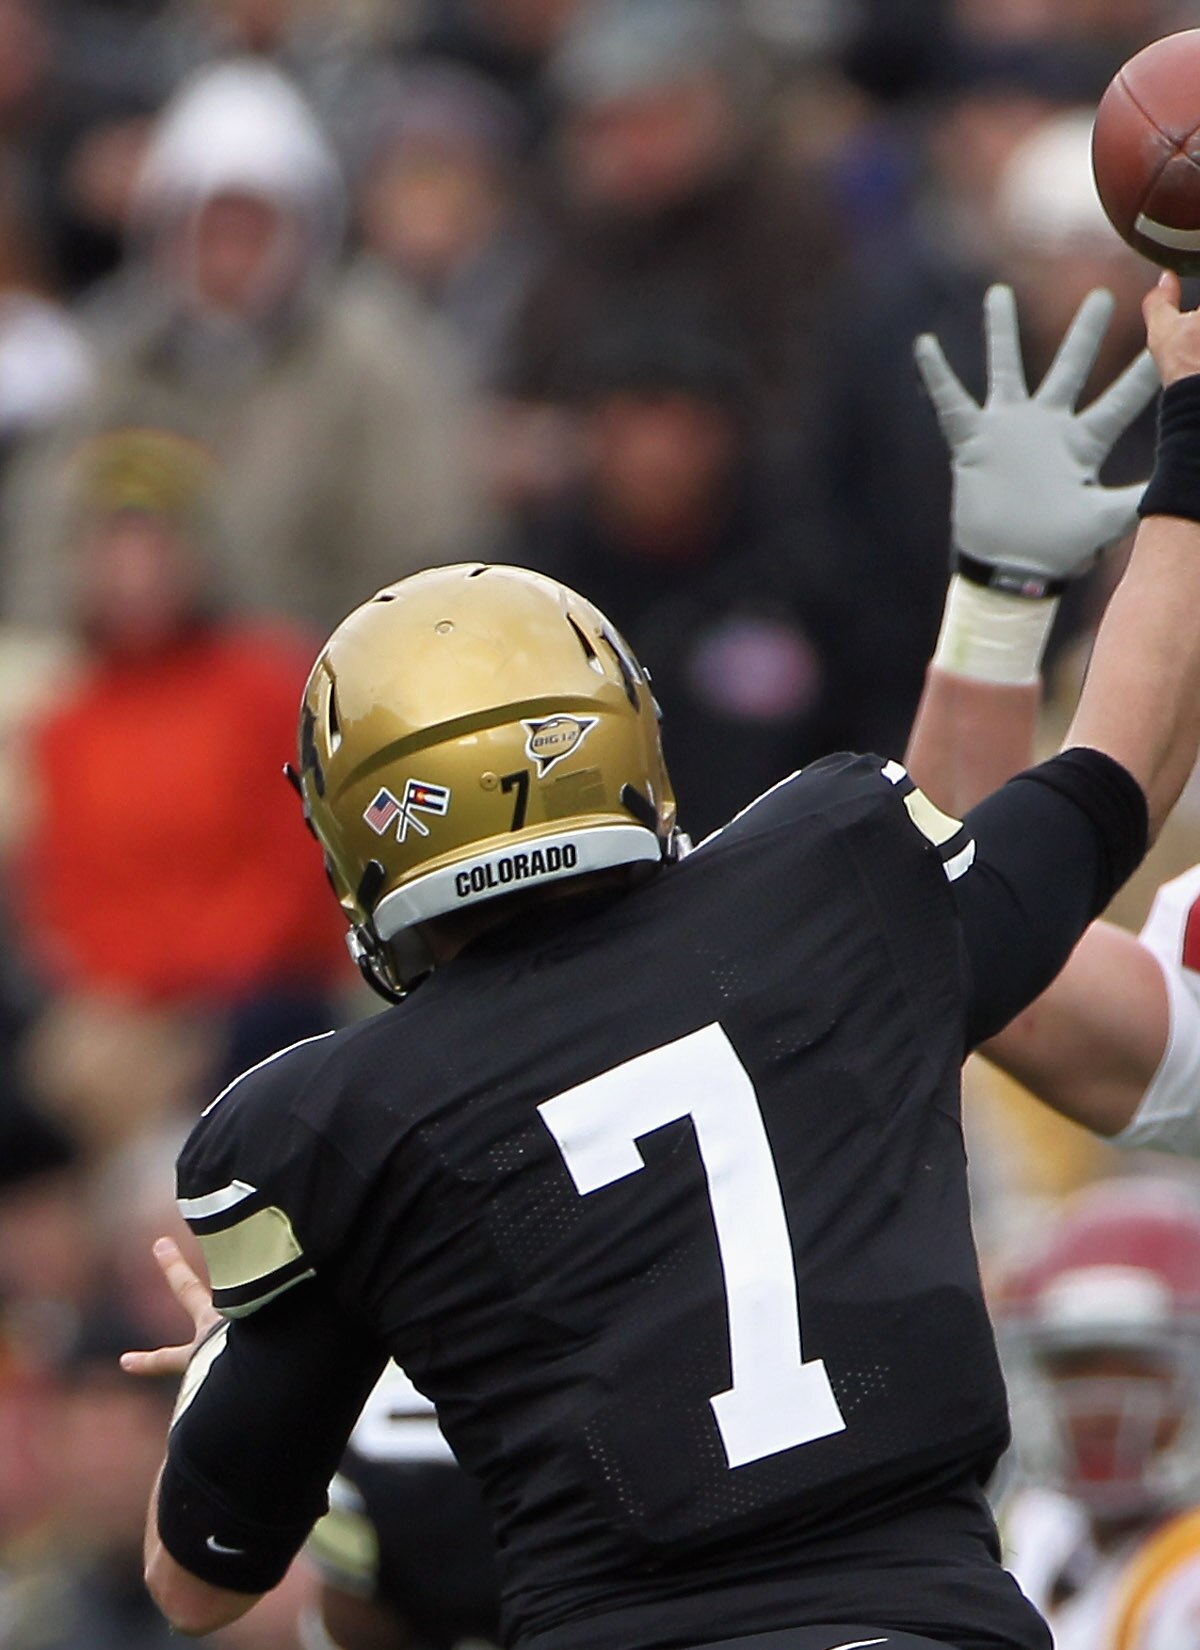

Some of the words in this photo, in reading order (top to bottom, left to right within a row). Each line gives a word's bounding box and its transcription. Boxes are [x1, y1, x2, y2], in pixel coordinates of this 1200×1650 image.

[534, 734, 559, 747] BIG
[562, 731, 576, 741] 12
[501, 770, 529, 832] 7
[456, 843, 577, 898] COLORADO
[536, 1020, 847, 1470] 7
